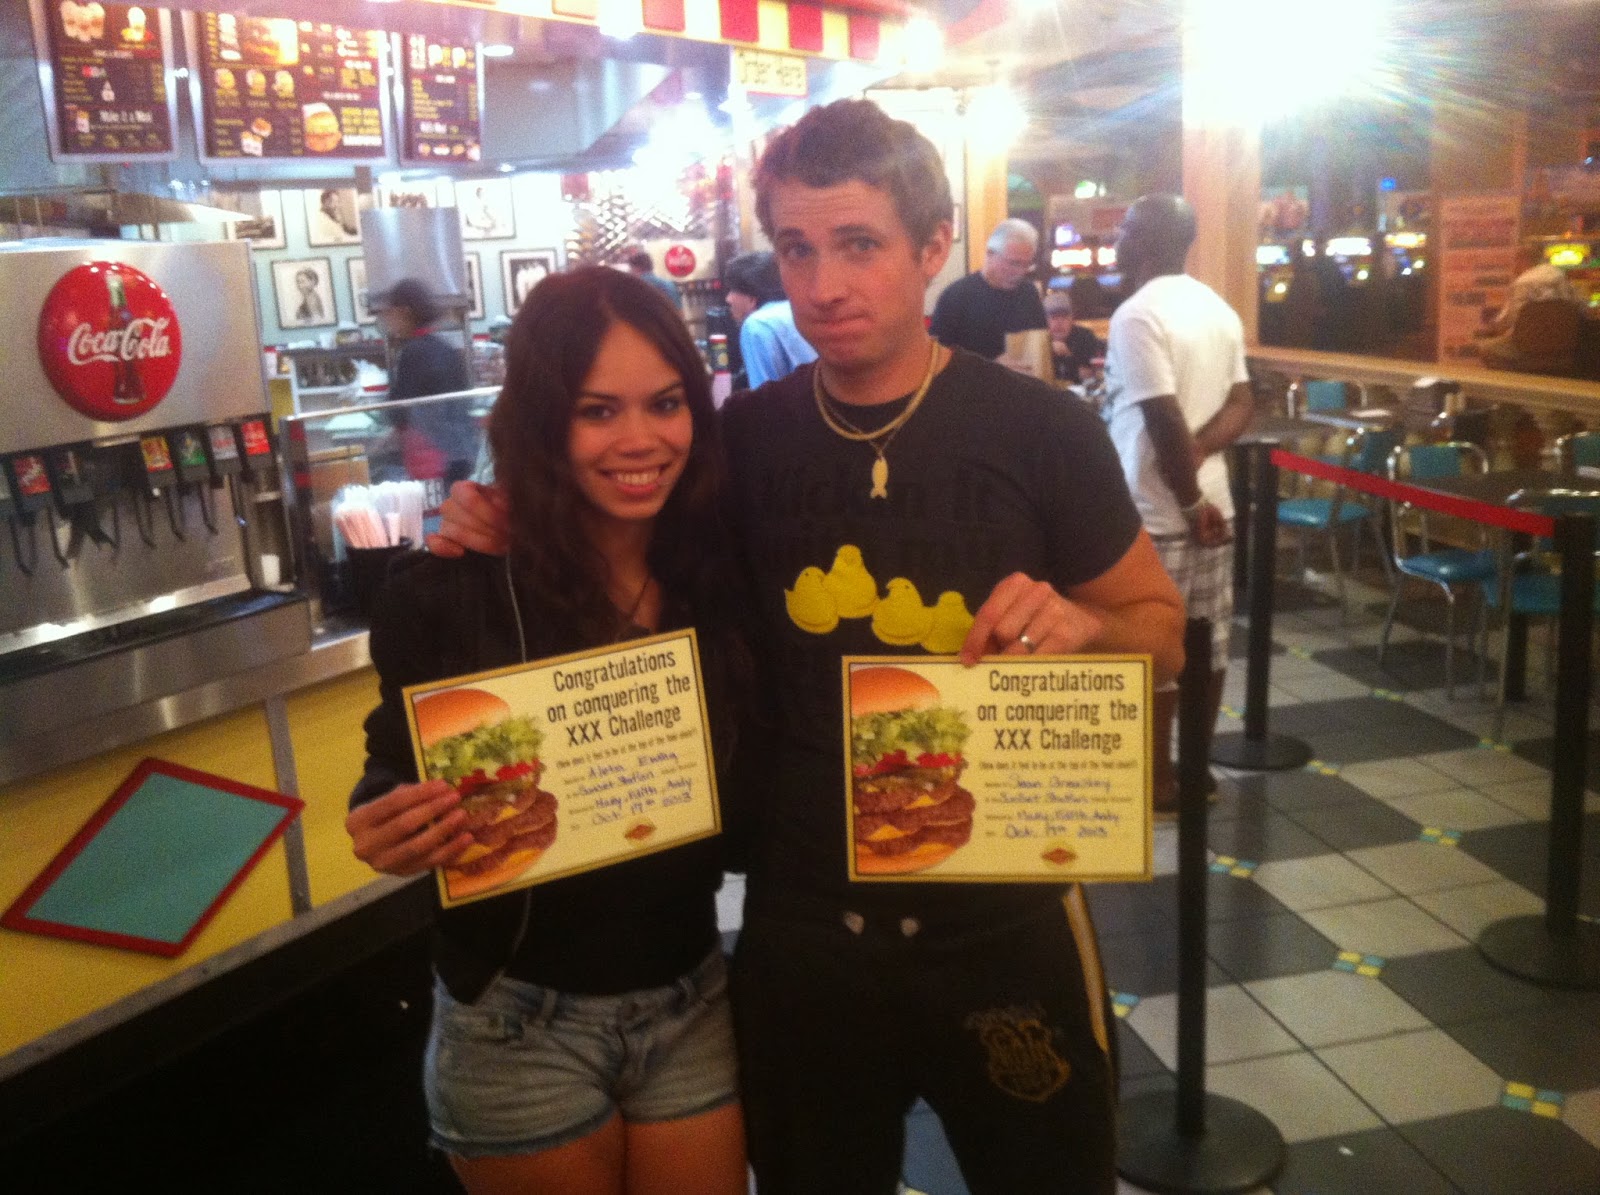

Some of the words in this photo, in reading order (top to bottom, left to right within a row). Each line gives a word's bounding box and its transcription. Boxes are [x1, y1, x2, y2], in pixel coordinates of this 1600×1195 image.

[553, 651, 676, 692] Congratulations
[989, 669, 1125, 696] Congratulations
[547, 705, 567, 723] on
[574, 684, 659, 718] conquering
[666, 673, 691, 695] the
[977, 703, 997, 721] on
[1005, 701, 1099, 726] conquering
[1110, 699, 1138, 721] the
[566, 721, 602, 747] XXX
[609, 706, 681, 736] Challenge
[994, 729, 1032, 750] XXX
[1040, 729, 1122, 754] Challenge
